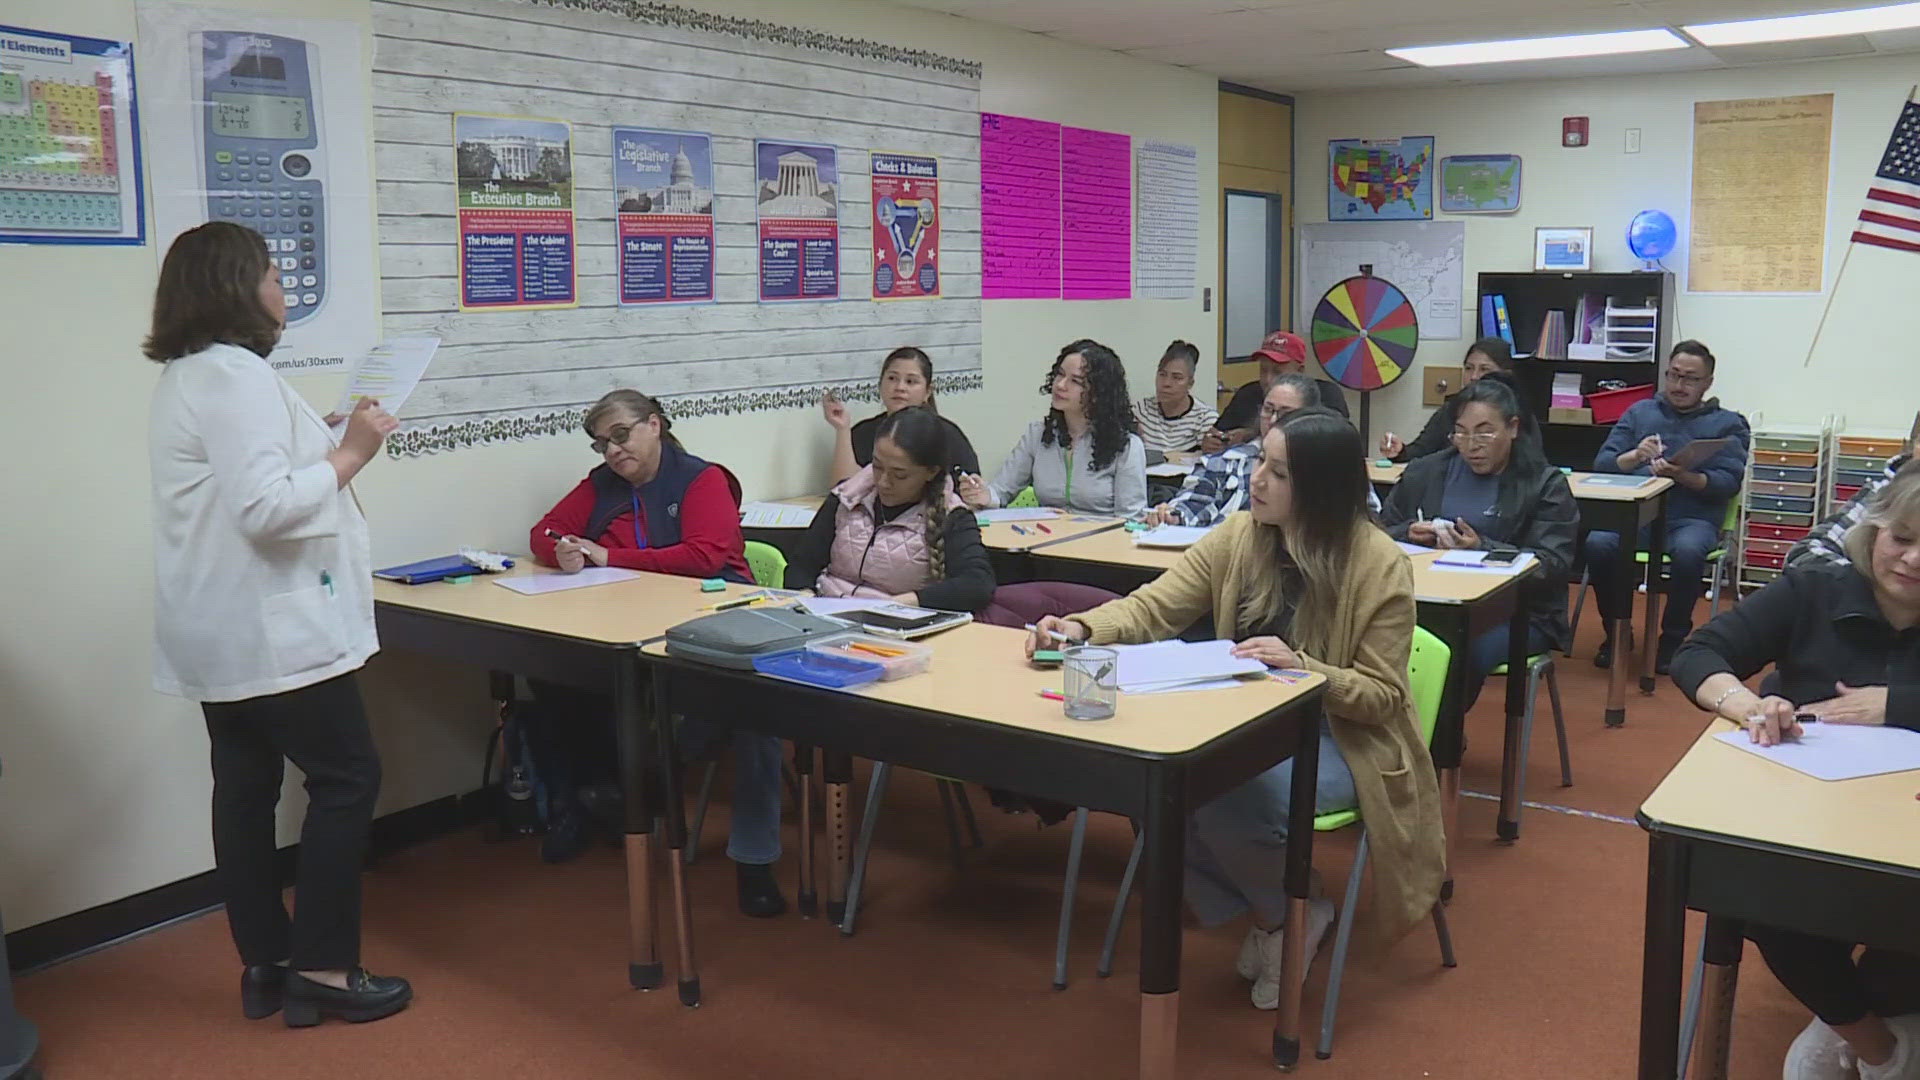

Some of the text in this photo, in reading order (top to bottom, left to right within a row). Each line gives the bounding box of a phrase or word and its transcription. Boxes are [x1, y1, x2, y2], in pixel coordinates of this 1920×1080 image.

[8, 40, 65, 56] Elements
[621, 139, 636, 150] The
[619, 148, 670, 165] Legislative
[636, 162, 661, 173] Branch
[876, 160, 899, 173] Checks
[484, 181, 500, 193] The
[471, 191, 561, 206] Executive Branch
[467, 235, 514, 246] The President
[527, 235, 566, 246] The Cabinet
[626, 241, 639, 251] The
[773, 249, 789, 258] Court
